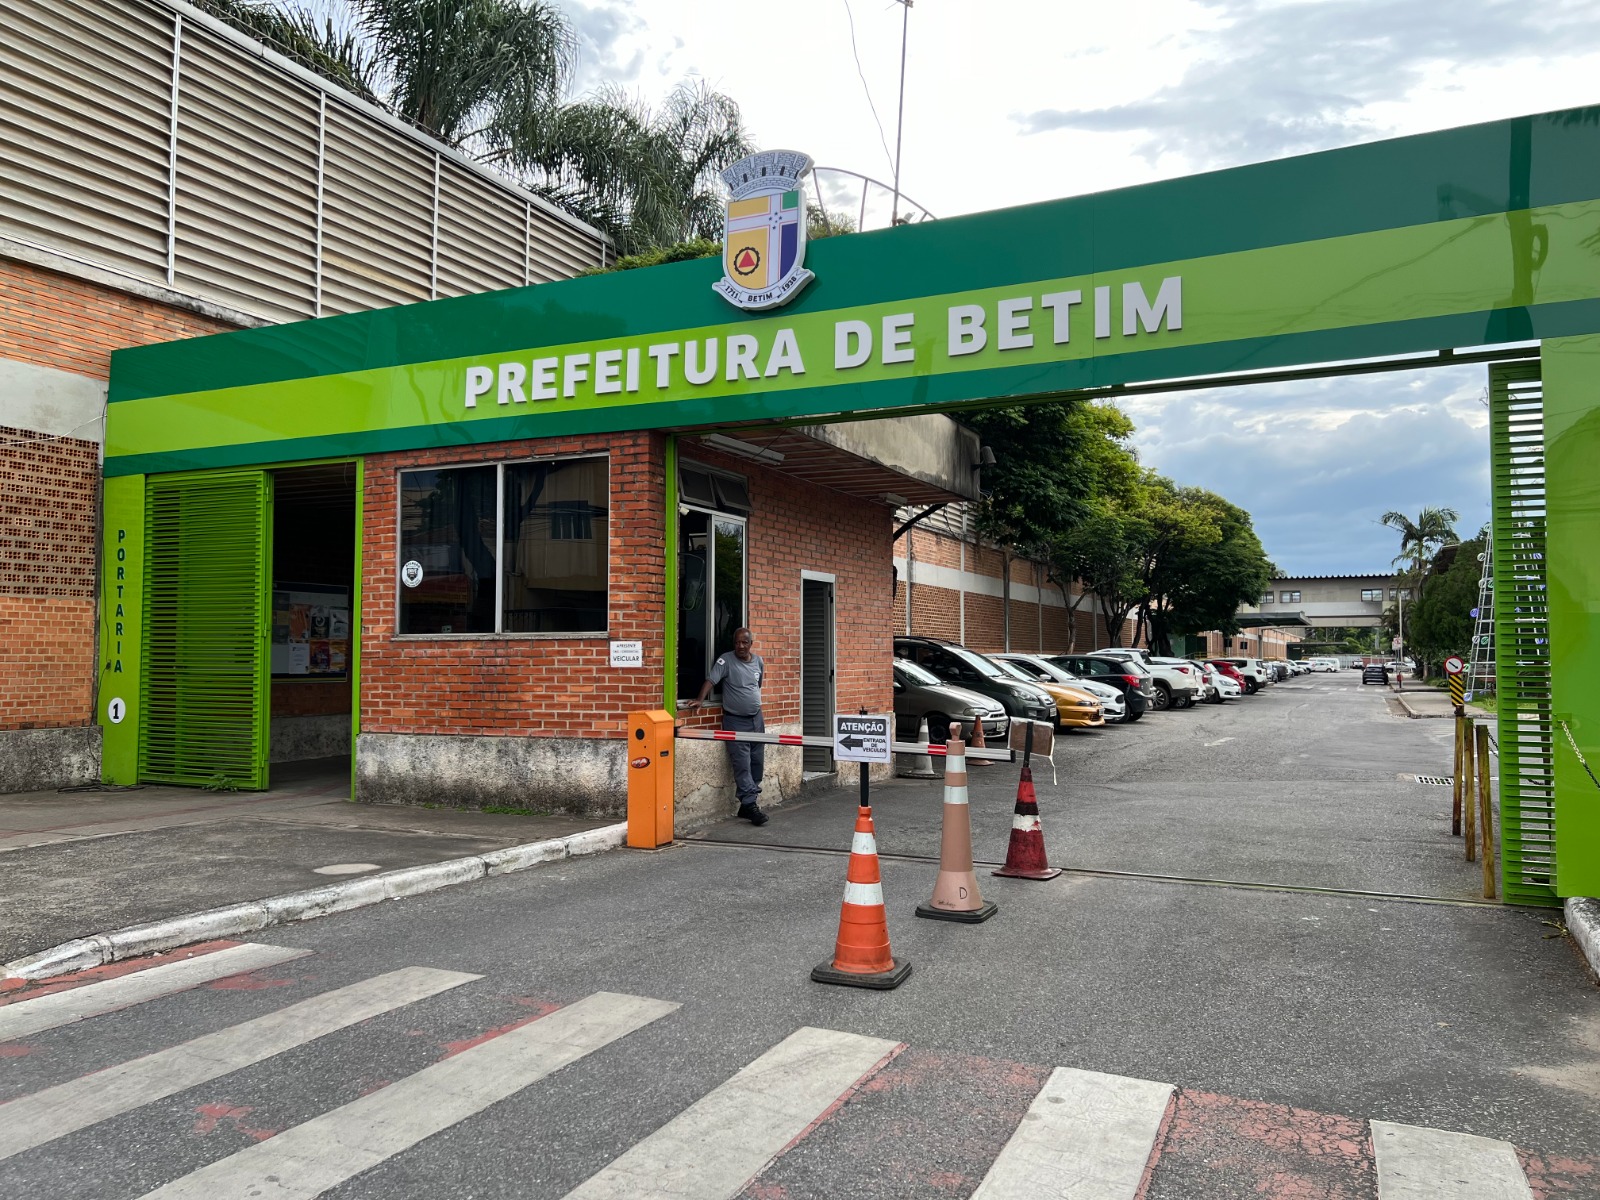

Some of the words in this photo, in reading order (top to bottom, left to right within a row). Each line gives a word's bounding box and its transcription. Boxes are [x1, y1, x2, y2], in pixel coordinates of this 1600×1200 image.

[725, 286, 739, 299] 1711
[747, 292, 773, 302] BETIM
[465, 328, 806, 408] PREFEITURA
[835, 313, 915, 370] DE
[948, 276, 1182, 356] BETIM
[114, 529, 126, 673] PORTARIA
[113, 703, 120, 719] 1
[840, 722, 884, 733] ATENÇÃO
[959, 887, 967, 899] D
